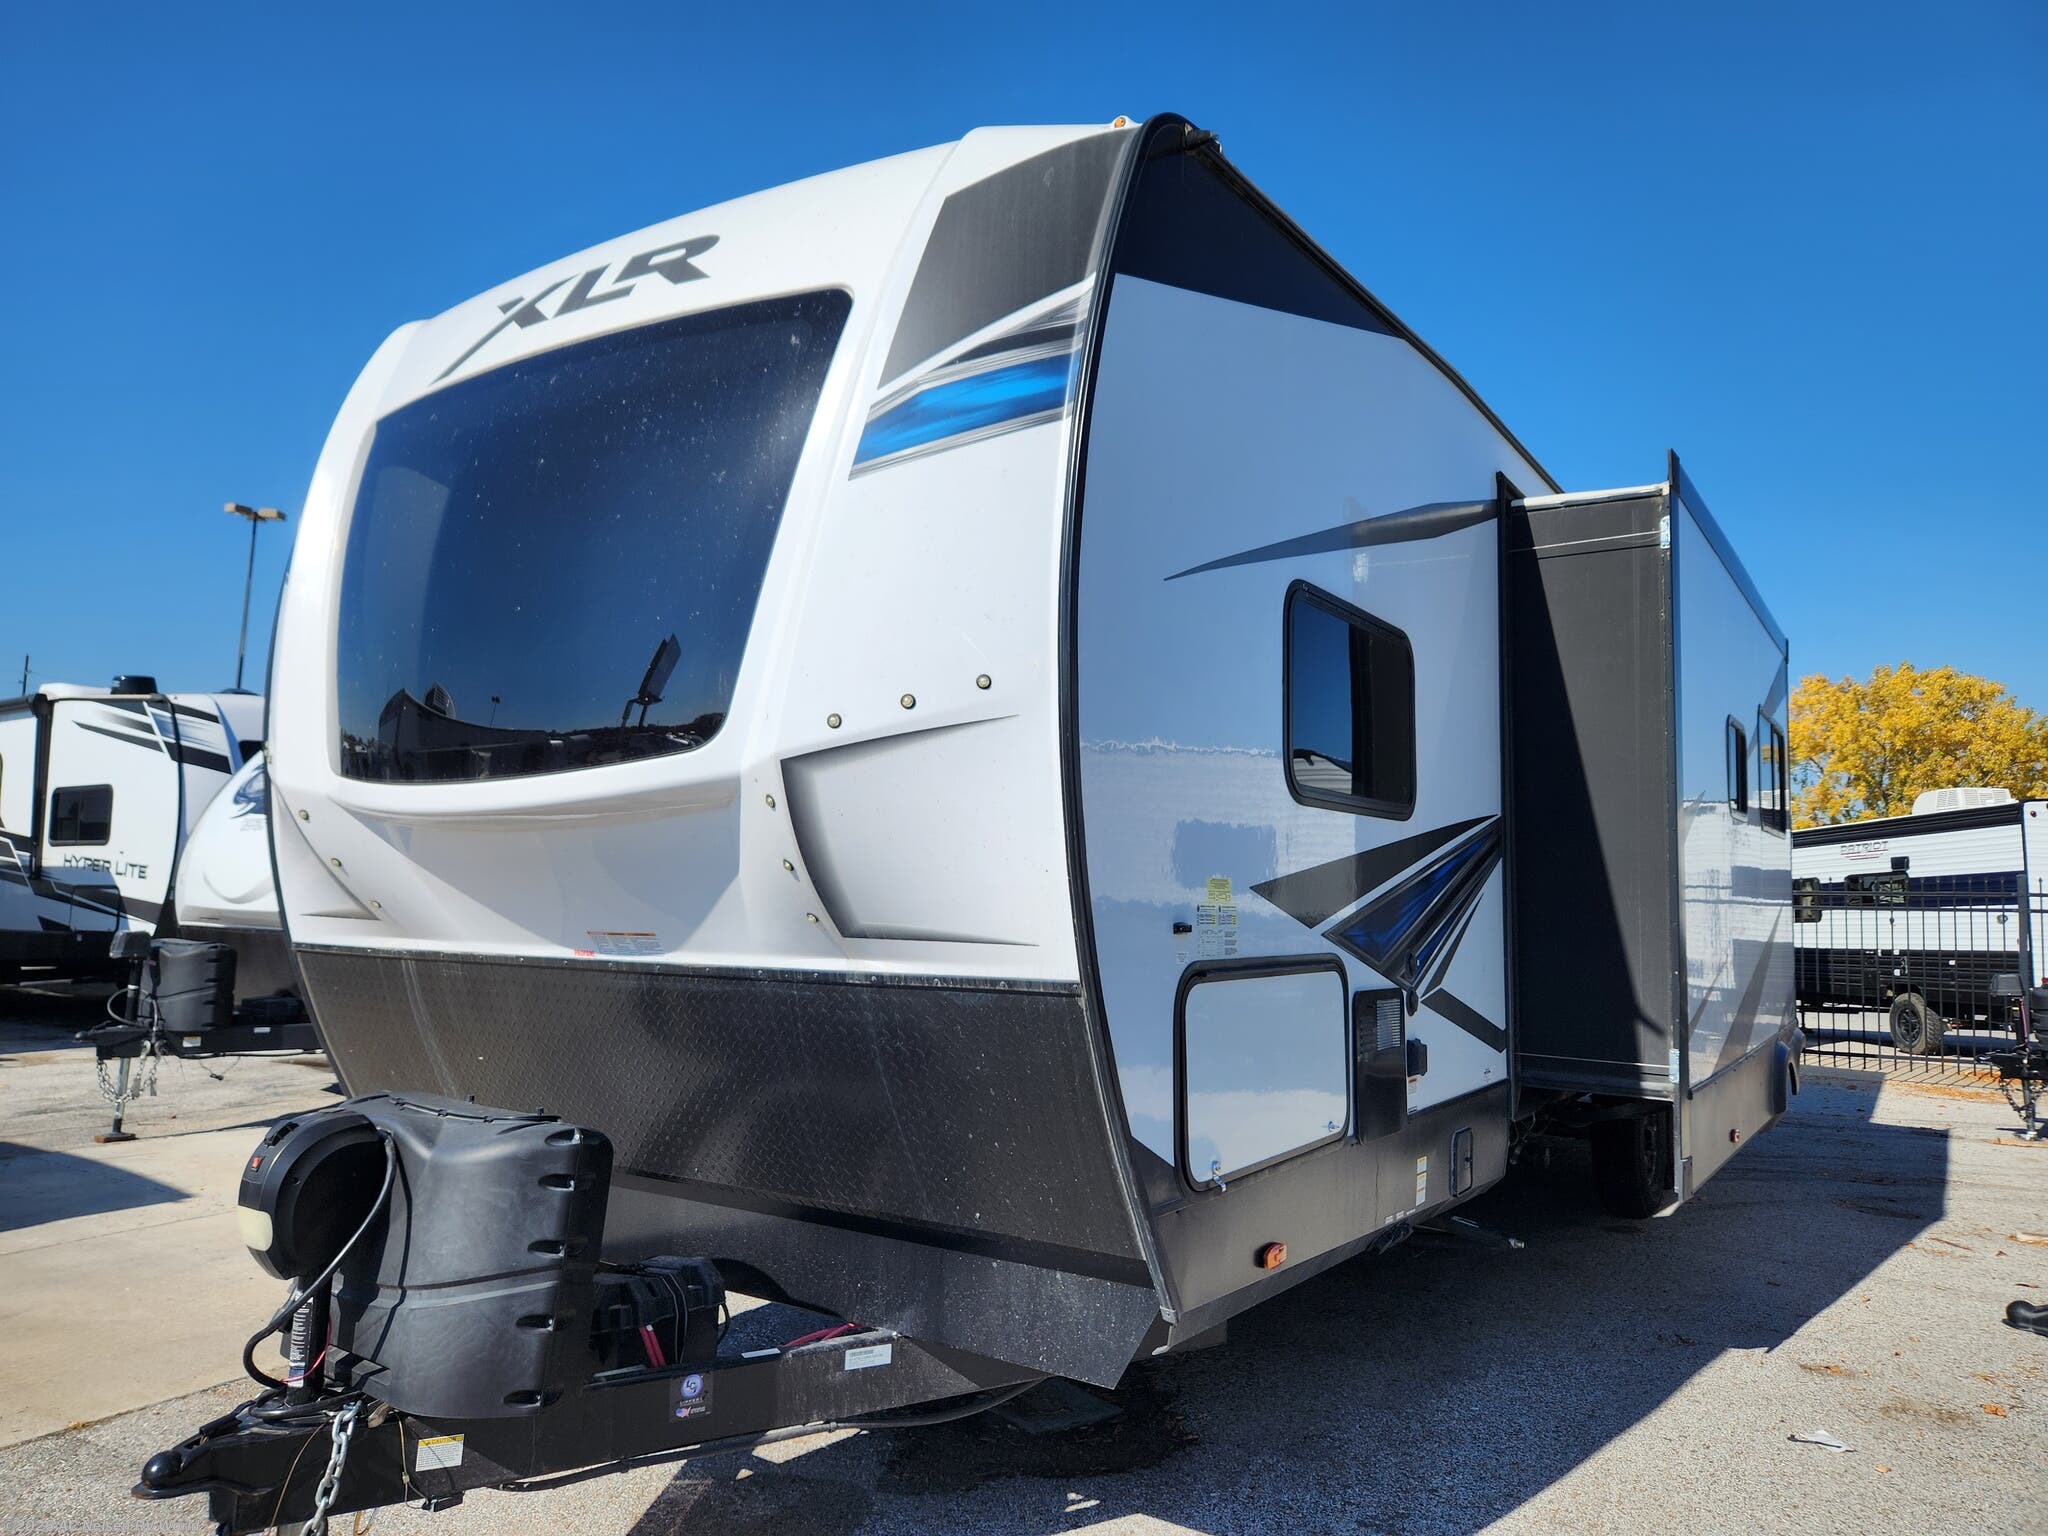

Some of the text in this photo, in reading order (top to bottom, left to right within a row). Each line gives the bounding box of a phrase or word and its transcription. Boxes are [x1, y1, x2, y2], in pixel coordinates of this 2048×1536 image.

[428, 234, 720, 386] XLR
[1840, 840, 1889, 852] PATRIOT
[63, 854, 149, 879] HYPER LITE
